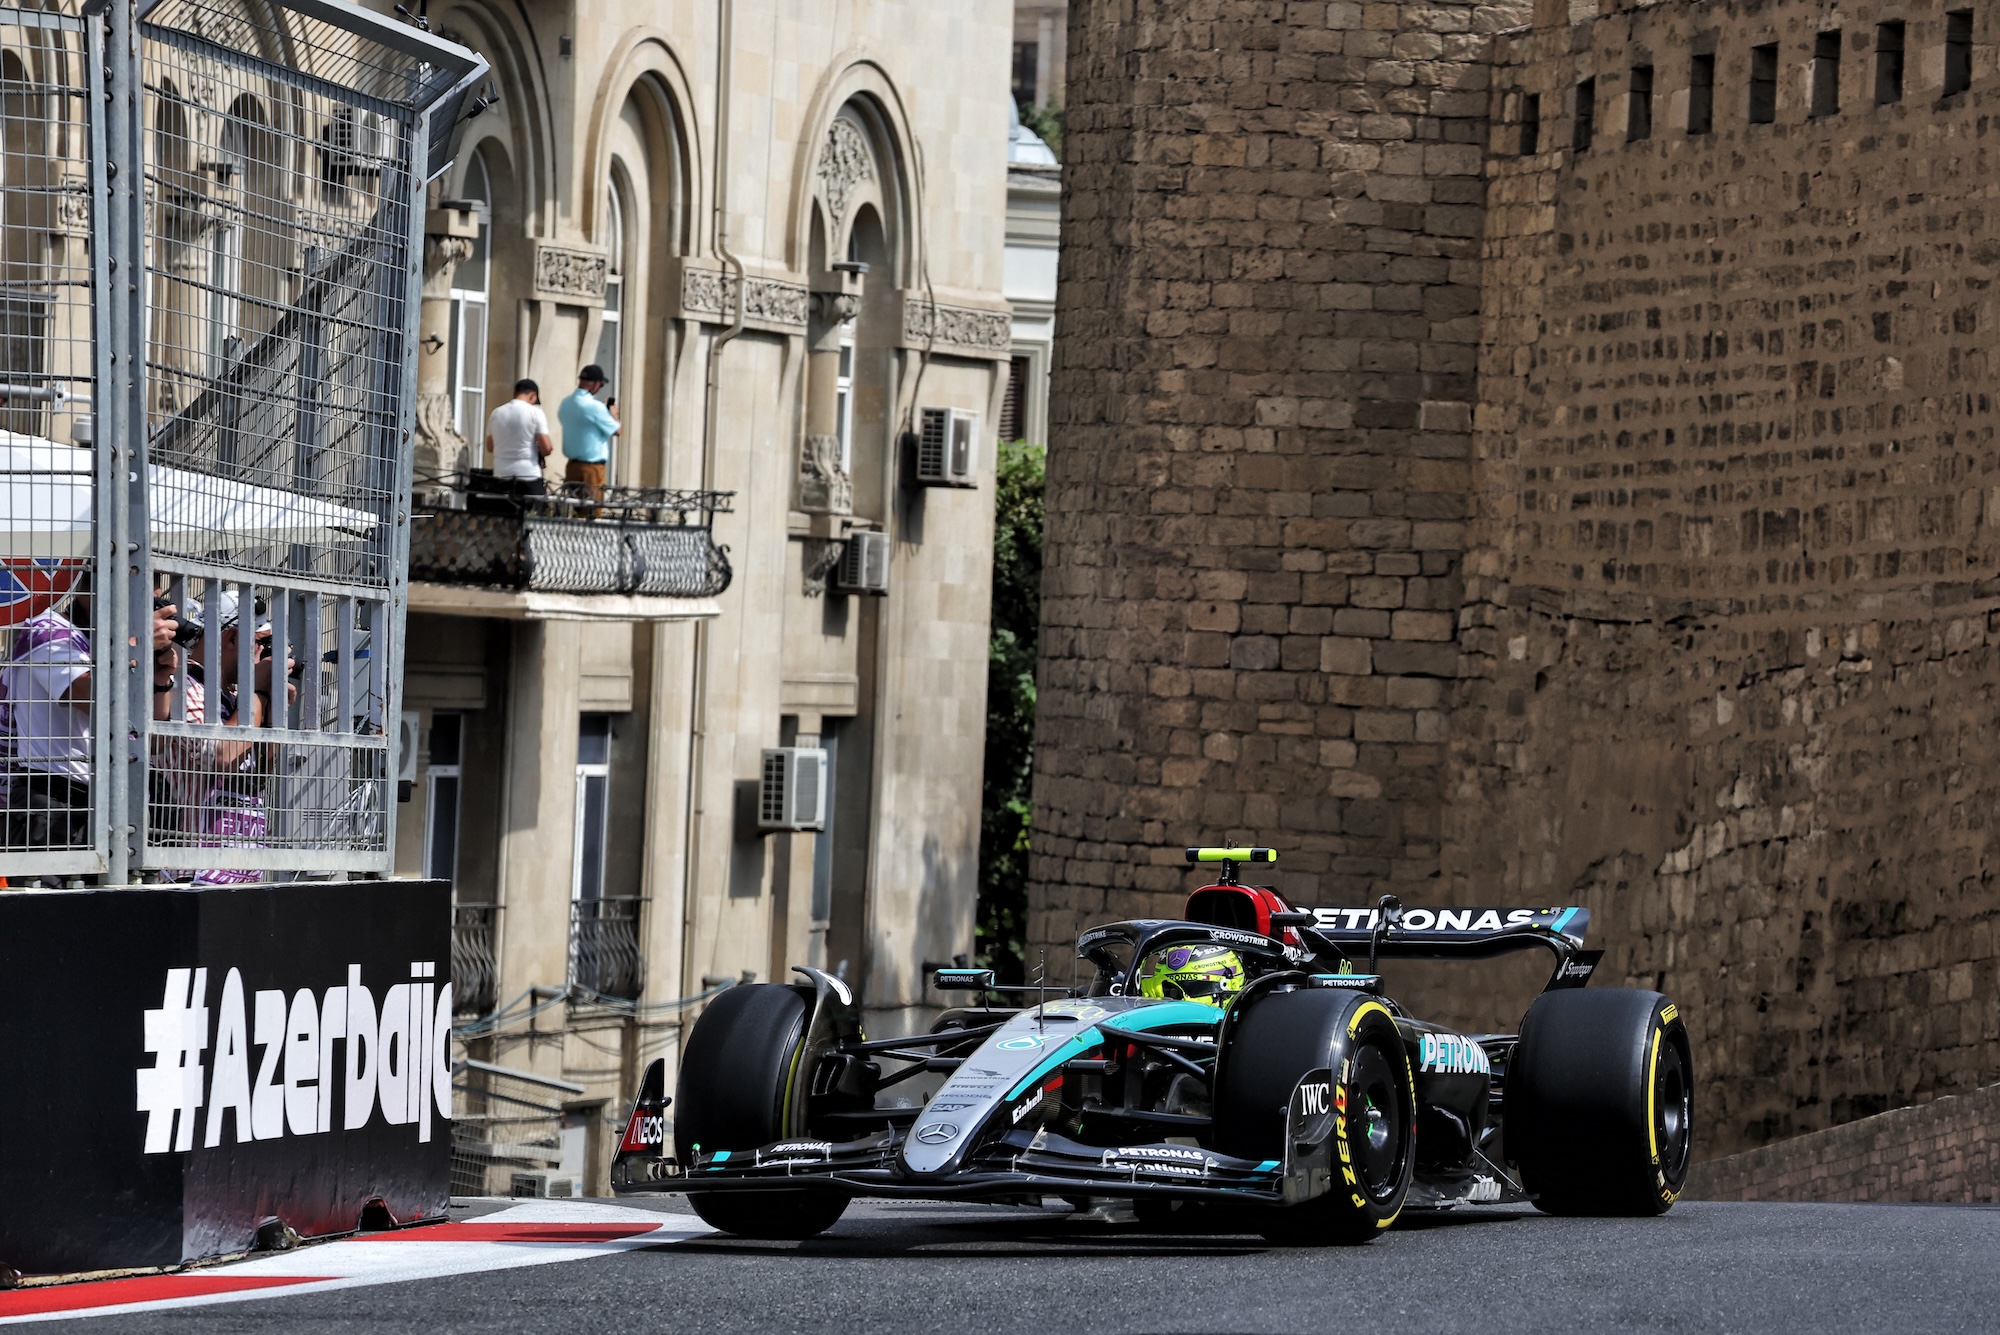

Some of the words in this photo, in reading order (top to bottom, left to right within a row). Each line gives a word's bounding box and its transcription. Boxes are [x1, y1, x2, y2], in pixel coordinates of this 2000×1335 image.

[1213, 931, 1269, 947] CROWDSTRIKE
[940, 975, 974, 983] PETRONAS
[1322, 979, 1366, 987] PETRONAS
[1300, 1083, 1330, 1115] IWC
[930, 1104, 966, 1112] SAP
[1012, 1087, 1044, 1125] Einhell
[630, 1116, 664, 1144] INEOS
[770, 1142, 832, 1153] PETRONAS
[1118, 1147, 1203, 1160] PETRONAS
